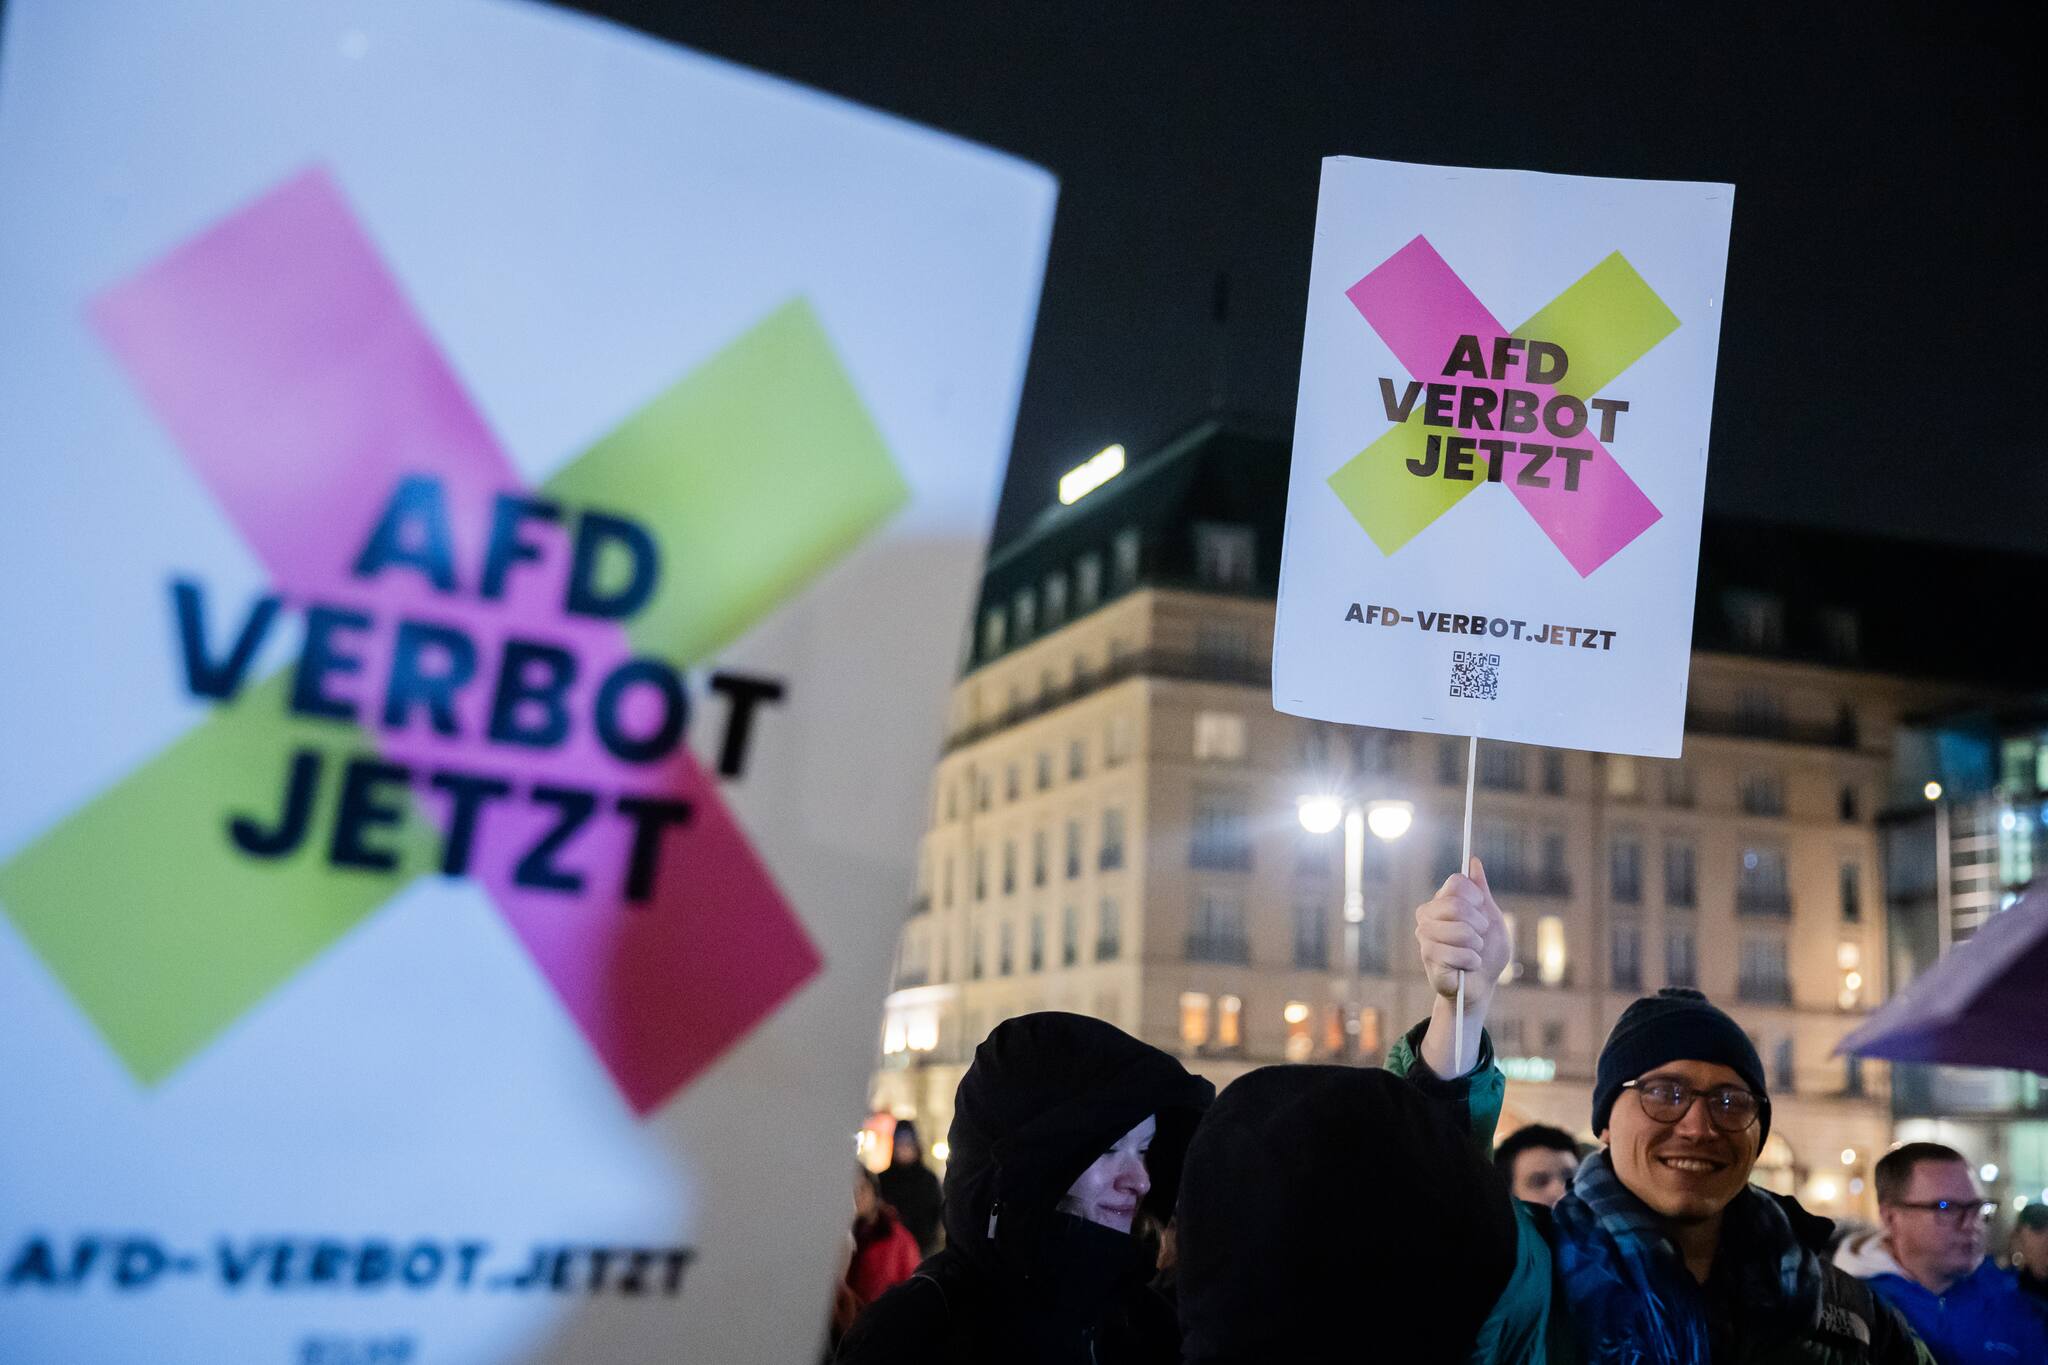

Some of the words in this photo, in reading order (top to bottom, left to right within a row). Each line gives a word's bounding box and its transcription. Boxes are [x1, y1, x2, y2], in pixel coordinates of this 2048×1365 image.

[1441, 334, 1569, 385] AFD
[1378, 377, 1630, 443] VERBOT
[1406, 434, 1593, 492] JETZT
[354, 472, 662, 622] AFD
[1344, 602, 1617, 651] AFD-VERBOT.JETZT
[166, 574, 787, 780] VERBOT
[225, 748, 693, 904] JETZT
